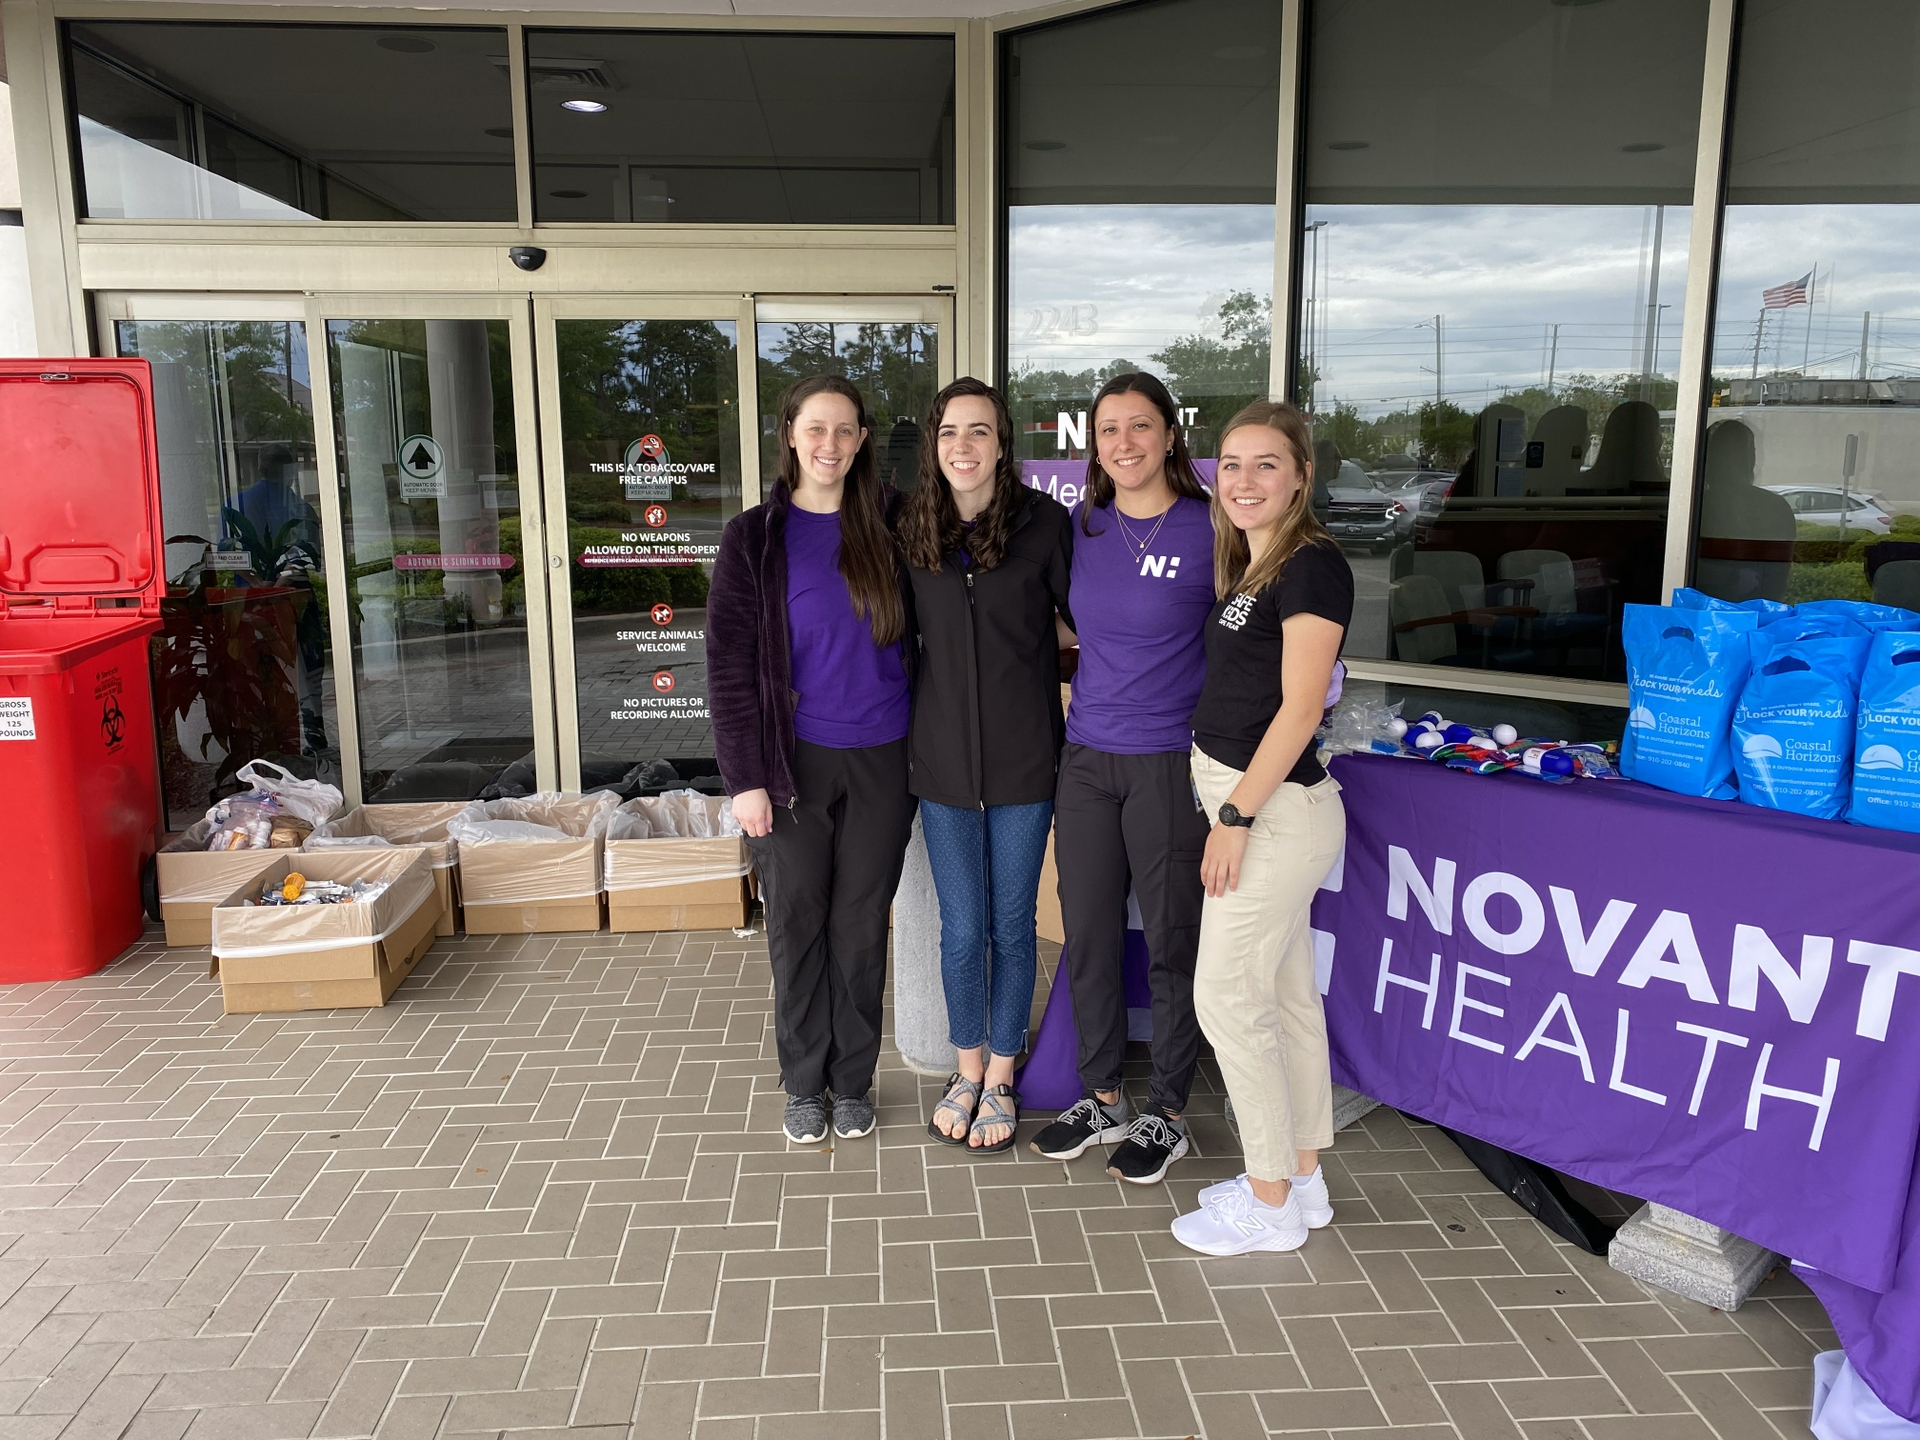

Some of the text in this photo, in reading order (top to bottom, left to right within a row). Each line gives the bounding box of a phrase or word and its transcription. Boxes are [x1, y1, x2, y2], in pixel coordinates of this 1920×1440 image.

[590, 463, 716, 473] THIS IS A TOBACCO/VAPE
[619, 475, 688, 485] FREE CAMPUS
[621, 533, 691, 543] NO WEAPONS
[584, 545, 634, 555] ALLOWED
[635, 545, 651, 555] ON
[653, 545, 676, 555] THIS
[408, 557, 502, 567] AUTOMATIC SLIDING DOOR
[1231, 592, 1258, 612] SAFE
[616, 630, 705, 641] SERVICE ANIMALS
[636, 642, 687, 652] WELCOME
[1635, 678, 1656, 689] LOCK
[623, 697, 704, 708] NO PICTURES OR
[611, 709, 668, 720] RECORDING
[1746, 699, 1849, 719] LOCK YOUR meds
[1658, 711, 1701, 727] Coastal
[1868, 713, 1899, 725] LOCK
[1658, 723, 1711, 740] Horizons
[1785, 738, 1832, 752] Coastal
[1647, 755, 1691, 769] 910-202-0840
[1785, 750, 1842, 763] Horizons
[1774, 786, 1824, 797] 910-202-0840
[1867, 796, 1893, 806] Office:
[1386, 843, 1920, 1042] NOVANT
[1373, 937, 1841, 1152] HEALTH
